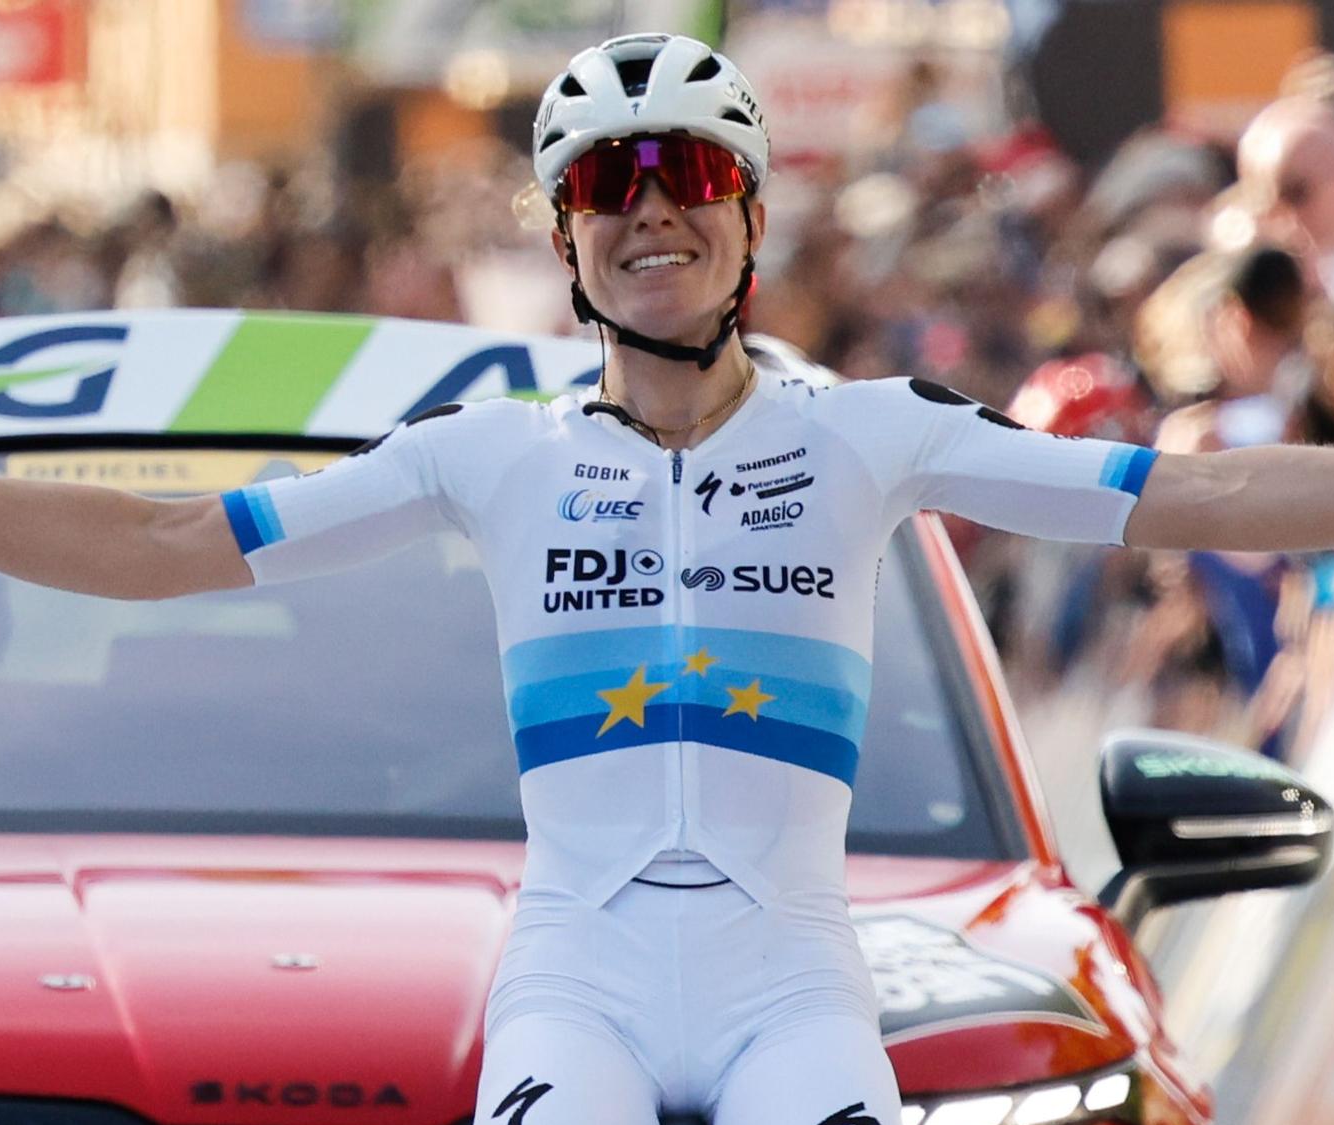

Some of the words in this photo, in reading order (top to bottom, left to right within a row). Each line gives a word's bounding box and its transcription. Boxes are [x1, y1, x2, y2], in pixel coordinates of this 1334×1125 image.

[398, 345, 603, 424] A
[574, 463, 631, 481] GOBIK
[735, 447, 807, 473] SHIMANO
[595, 500, 645, 516] UEC
[545, 549, 628, 586] FDJ
[543, 588, 665, 613] UNITED
